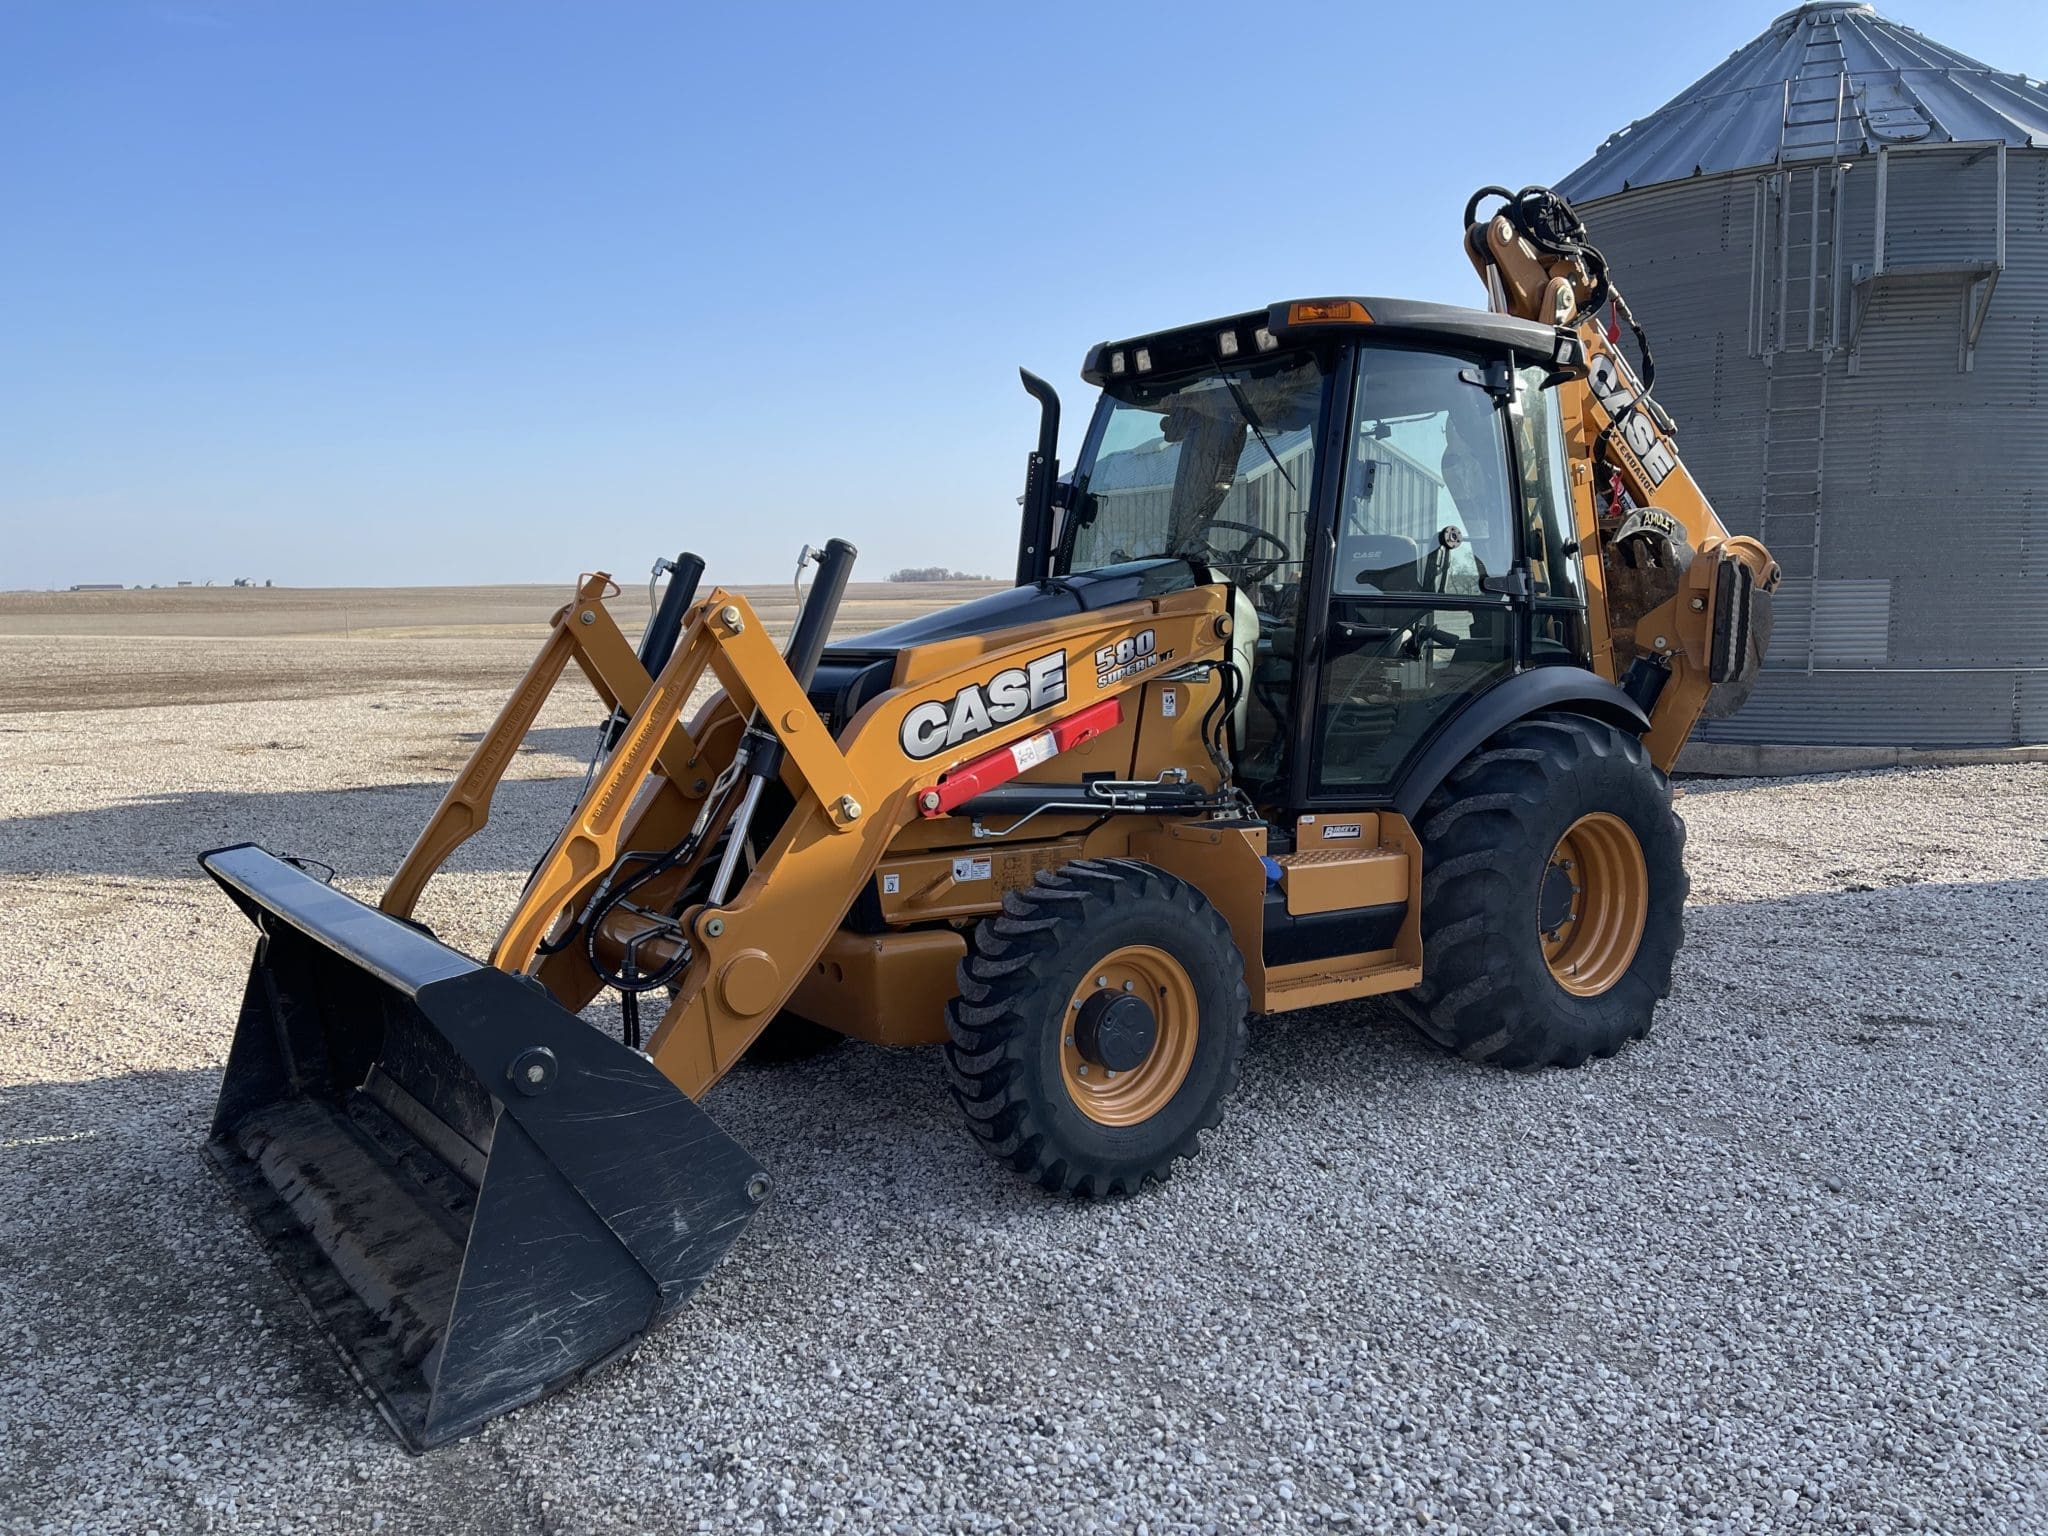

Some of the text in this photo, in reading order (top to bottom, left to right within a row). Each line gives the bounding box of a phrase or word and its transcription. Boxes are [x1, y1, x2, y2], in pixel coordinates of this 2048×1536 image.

[1588, 354, 1677, 488] CASE
[1605, 426, 1656, 496] XTENDAHOE
[1352, 551, 1382, 559] CASE
[1095, 629, 1155, 674] 580
[1097, 648, 1174, 688] SUPER N WT
[899, 649, 1067, 760] CASE
